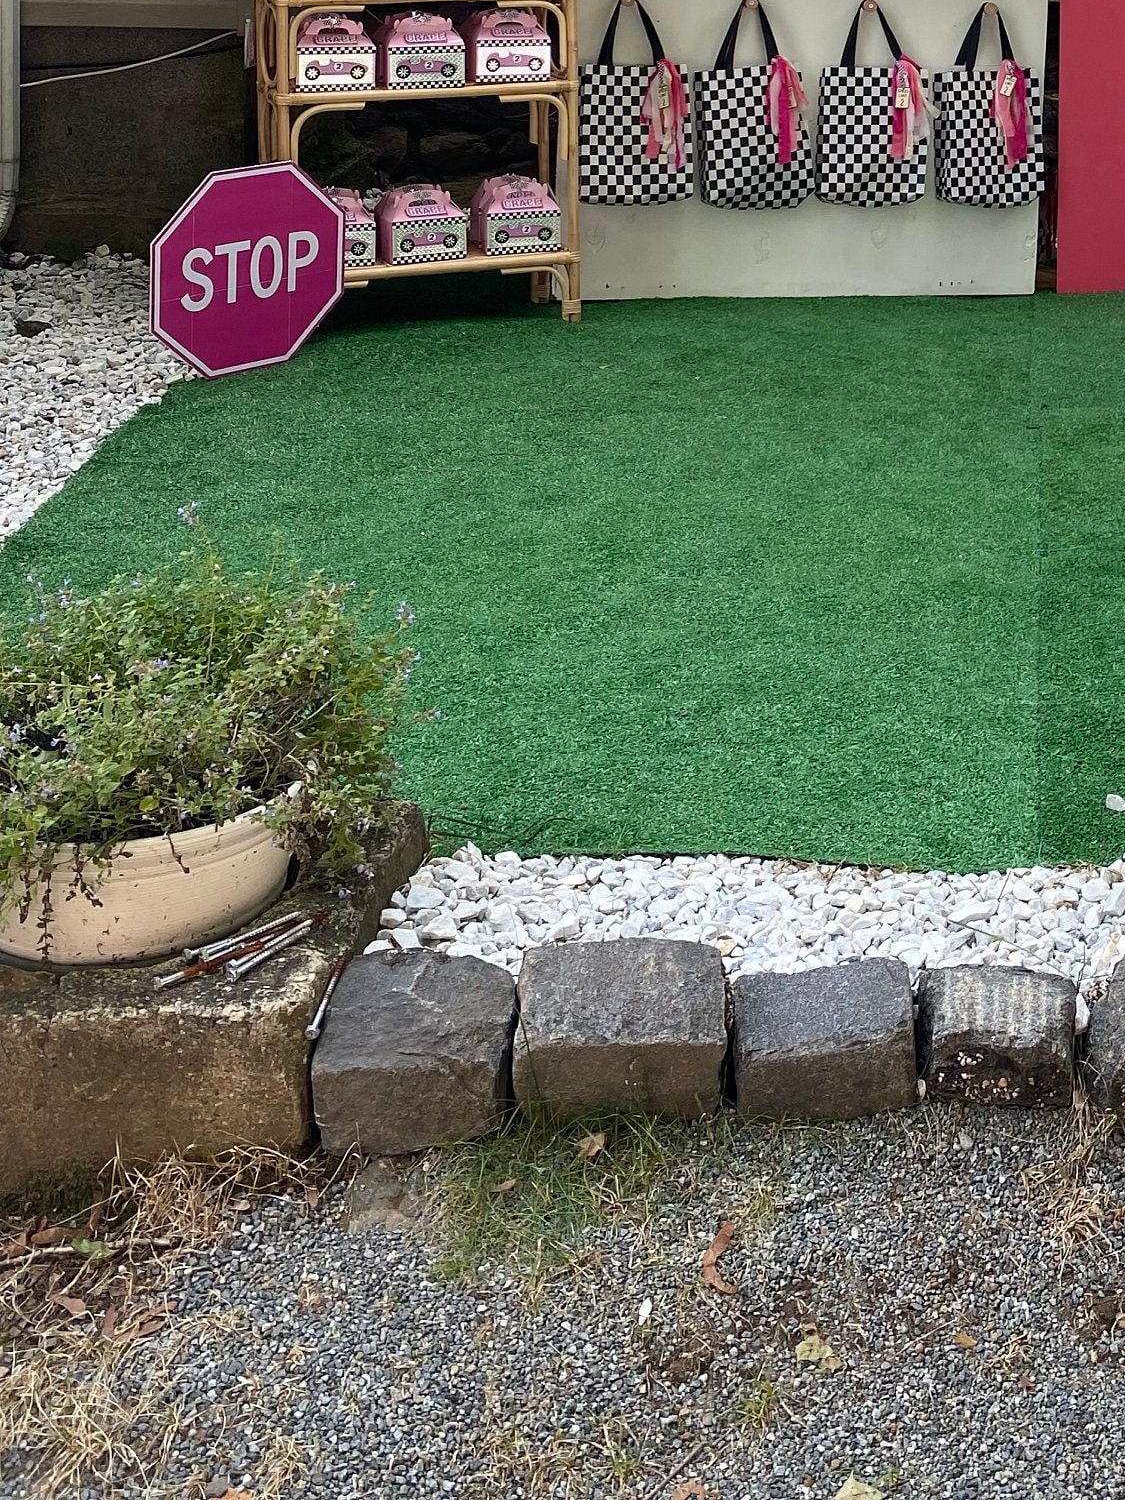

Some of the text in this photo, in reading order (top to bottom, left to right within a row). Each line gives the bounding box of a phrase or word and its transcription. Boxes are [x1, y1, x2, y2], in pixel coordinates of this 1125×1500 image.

[505, 198, 542, 208] GRACE
[408, 205, 446, 216] GRACE
[523, 225, 530, 233] 2
[429, 233, 435, 241] 2
[180, 230, 320, 312] STOP
